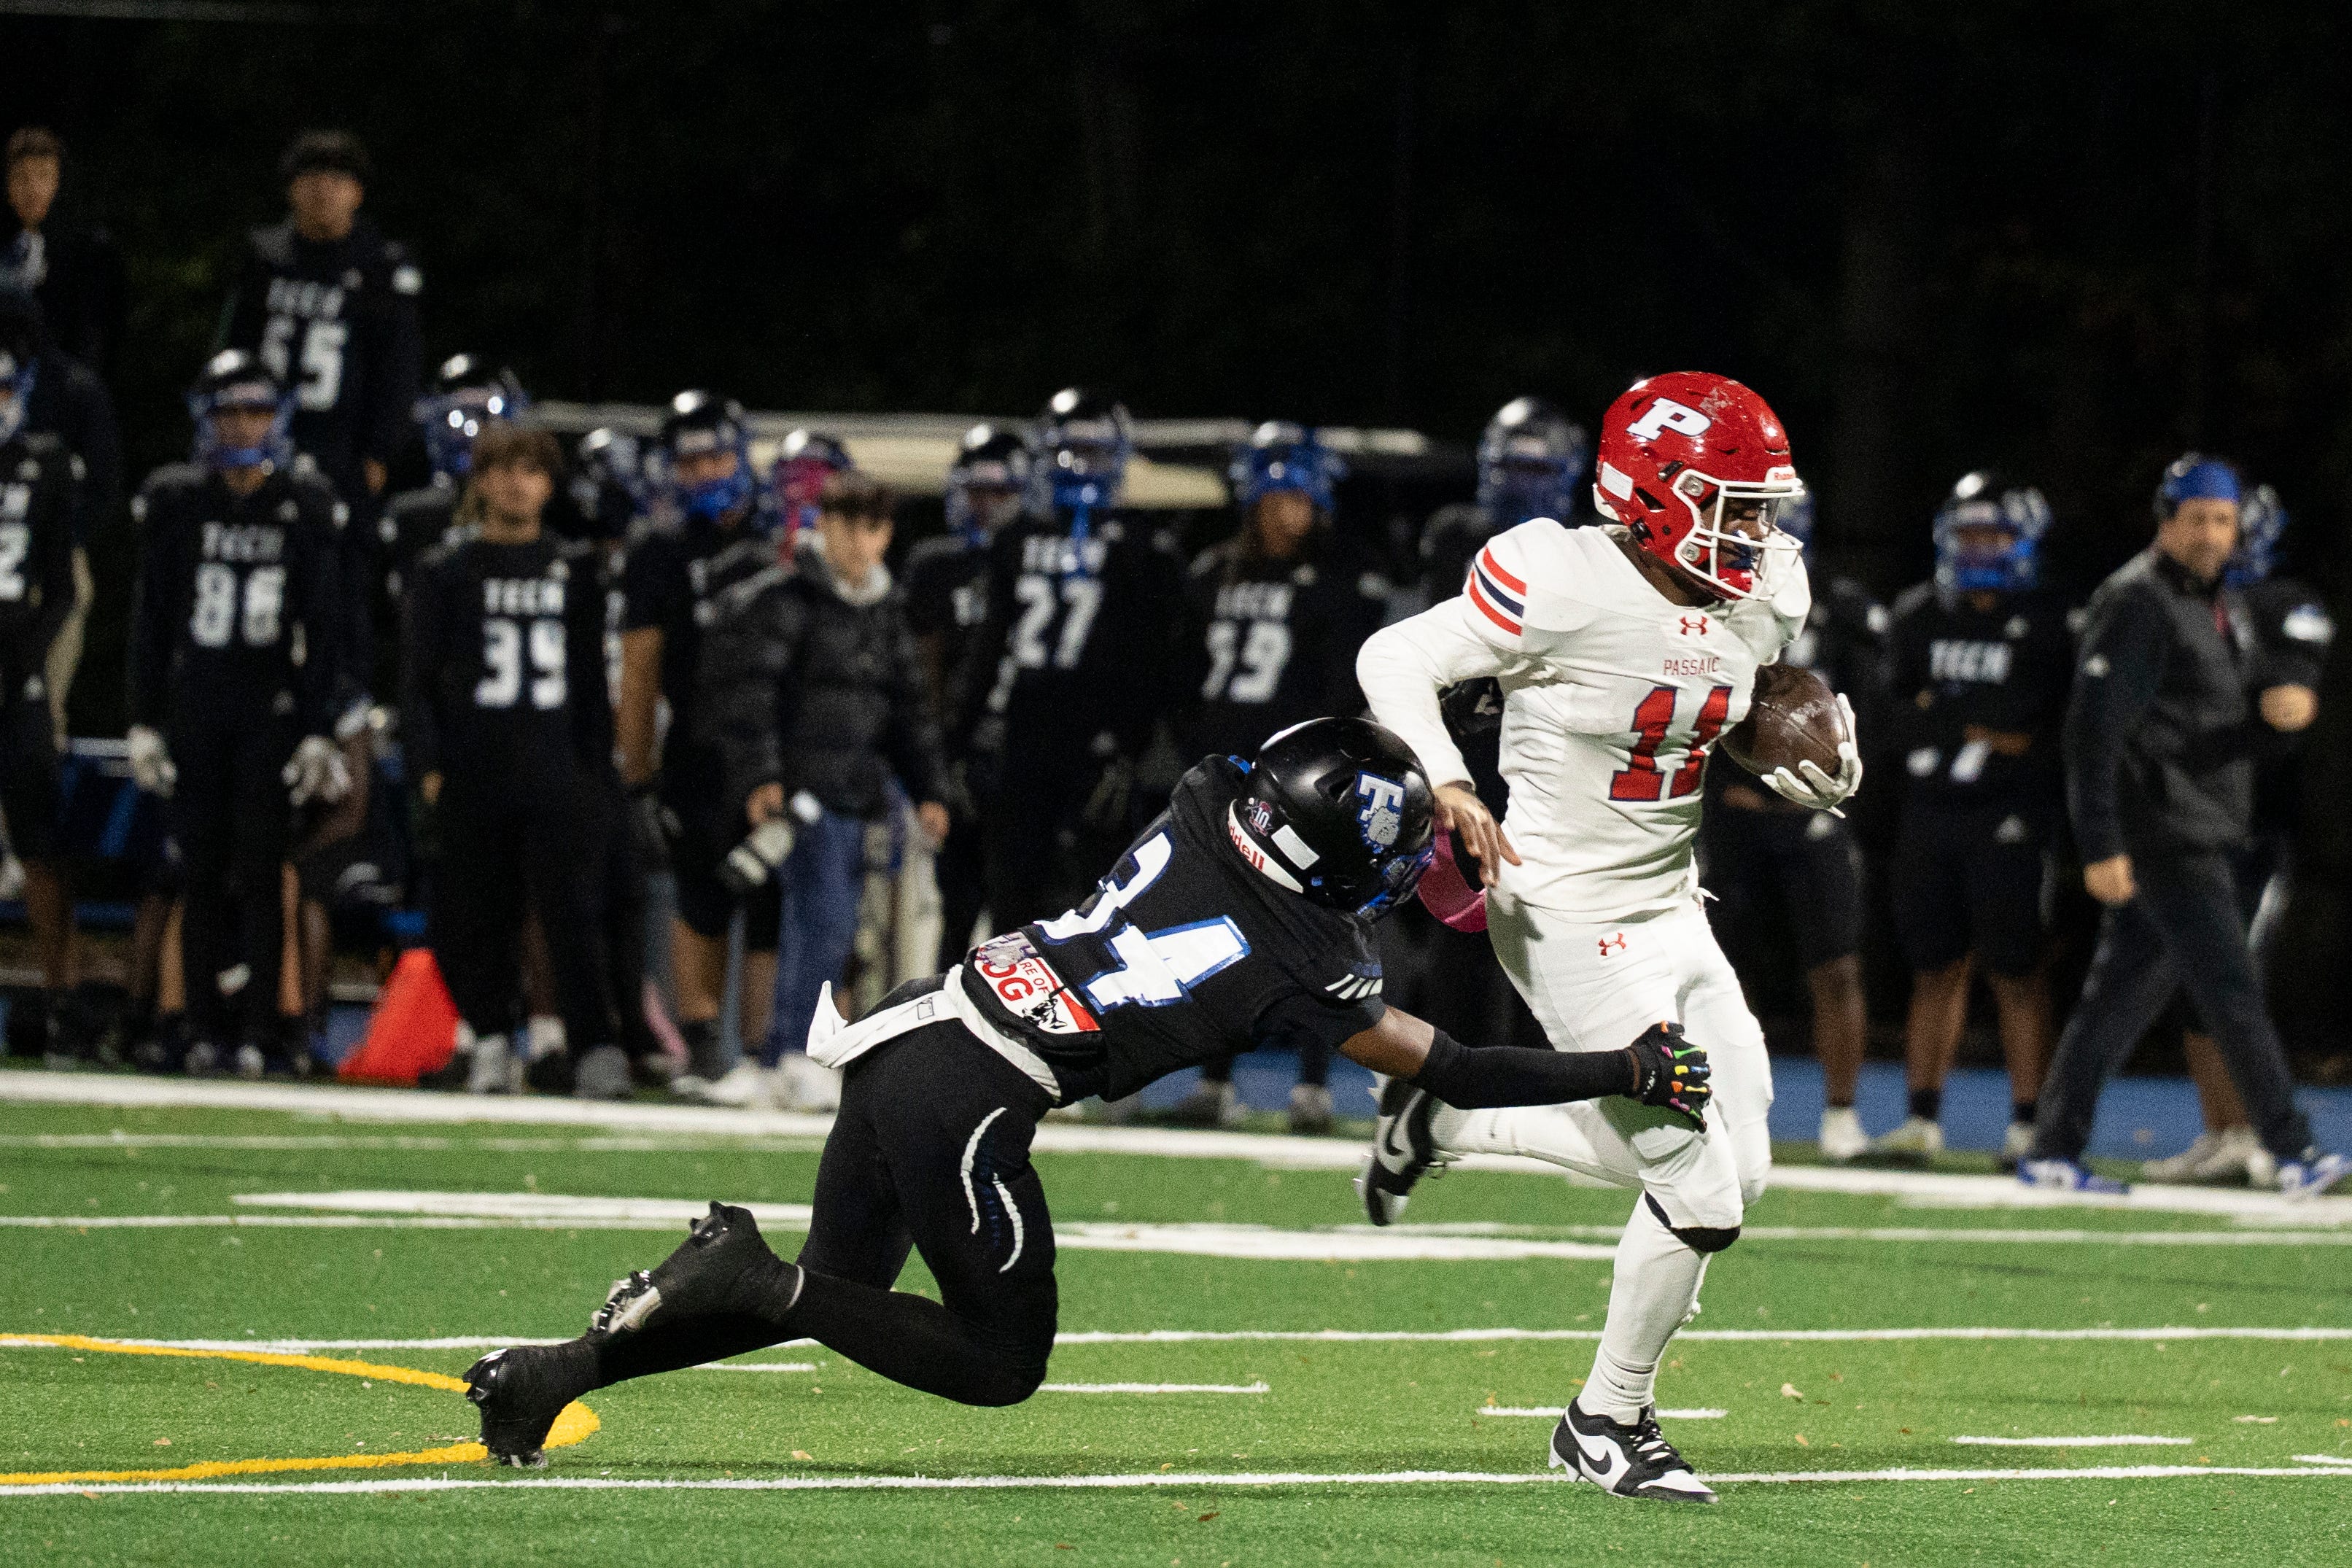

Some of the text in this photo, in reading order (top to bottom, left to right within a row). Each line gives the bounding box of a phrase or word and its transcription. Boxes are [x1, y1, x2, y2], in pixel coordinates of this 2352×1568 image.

[1626, 397, 1712, 441] P
[1014, 574, 1102, 669] 27
[1663, 656, 1720, 675] PASSAIC
[1608, 685, 1734, 802] 11
[1030, 828, 1252, 1015] 34
